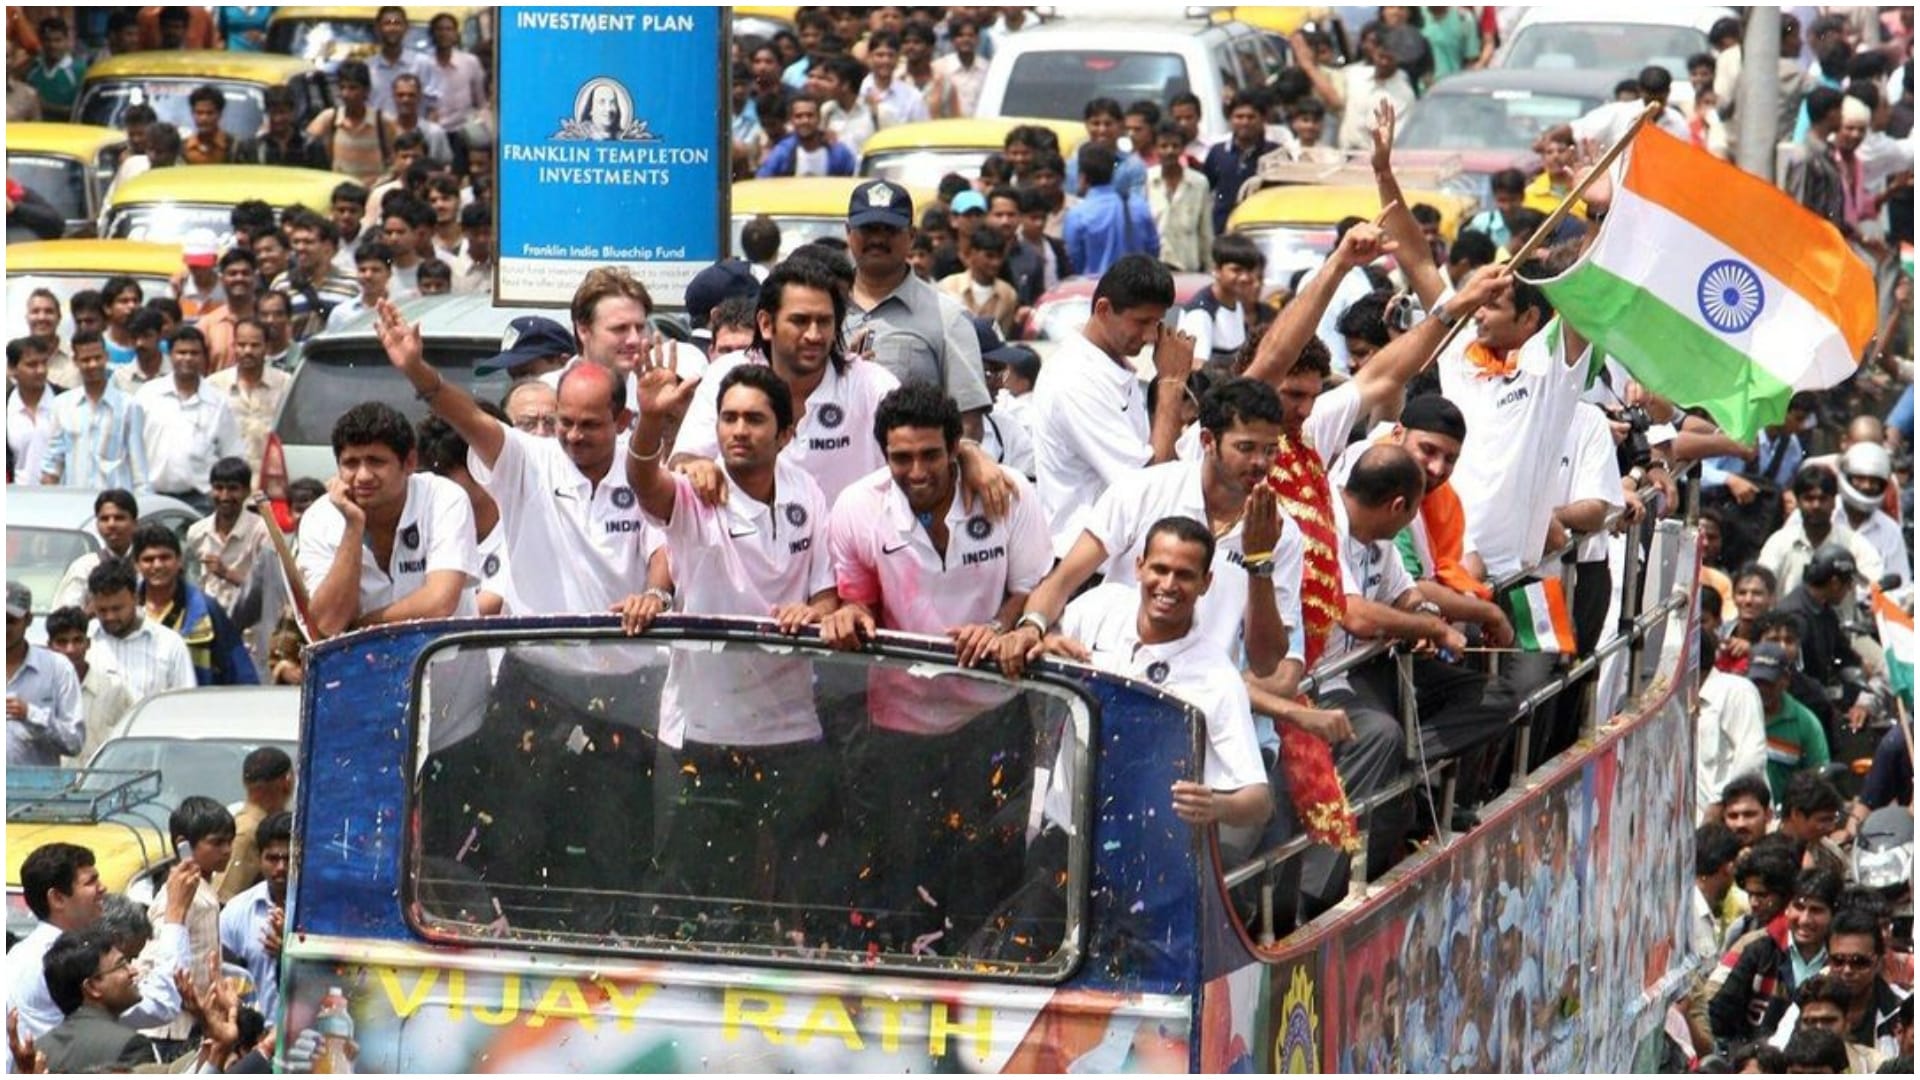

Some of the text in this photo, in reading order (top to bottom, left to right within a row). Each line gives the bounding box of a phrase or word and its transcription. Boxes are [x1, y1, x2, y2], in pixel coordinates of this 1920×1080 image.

[516, 11, 694, 32] INVESTMENT PLAN
[503, 145, 709, 164] FRANKLIN TEMPLETON
[539, 168, 669, 186] INVESTMENTS
[523, 244, 685, 259] Franklin India Bluechip Fund
[1497, 387, 1528, 408] INDIA
[809, 436, 850, 451] INDIA
[789, 537, 812, 554] IND
[962, 546, 1005, 565] INDIA
[375, 966, 993, 1056] VIJAY RATH
